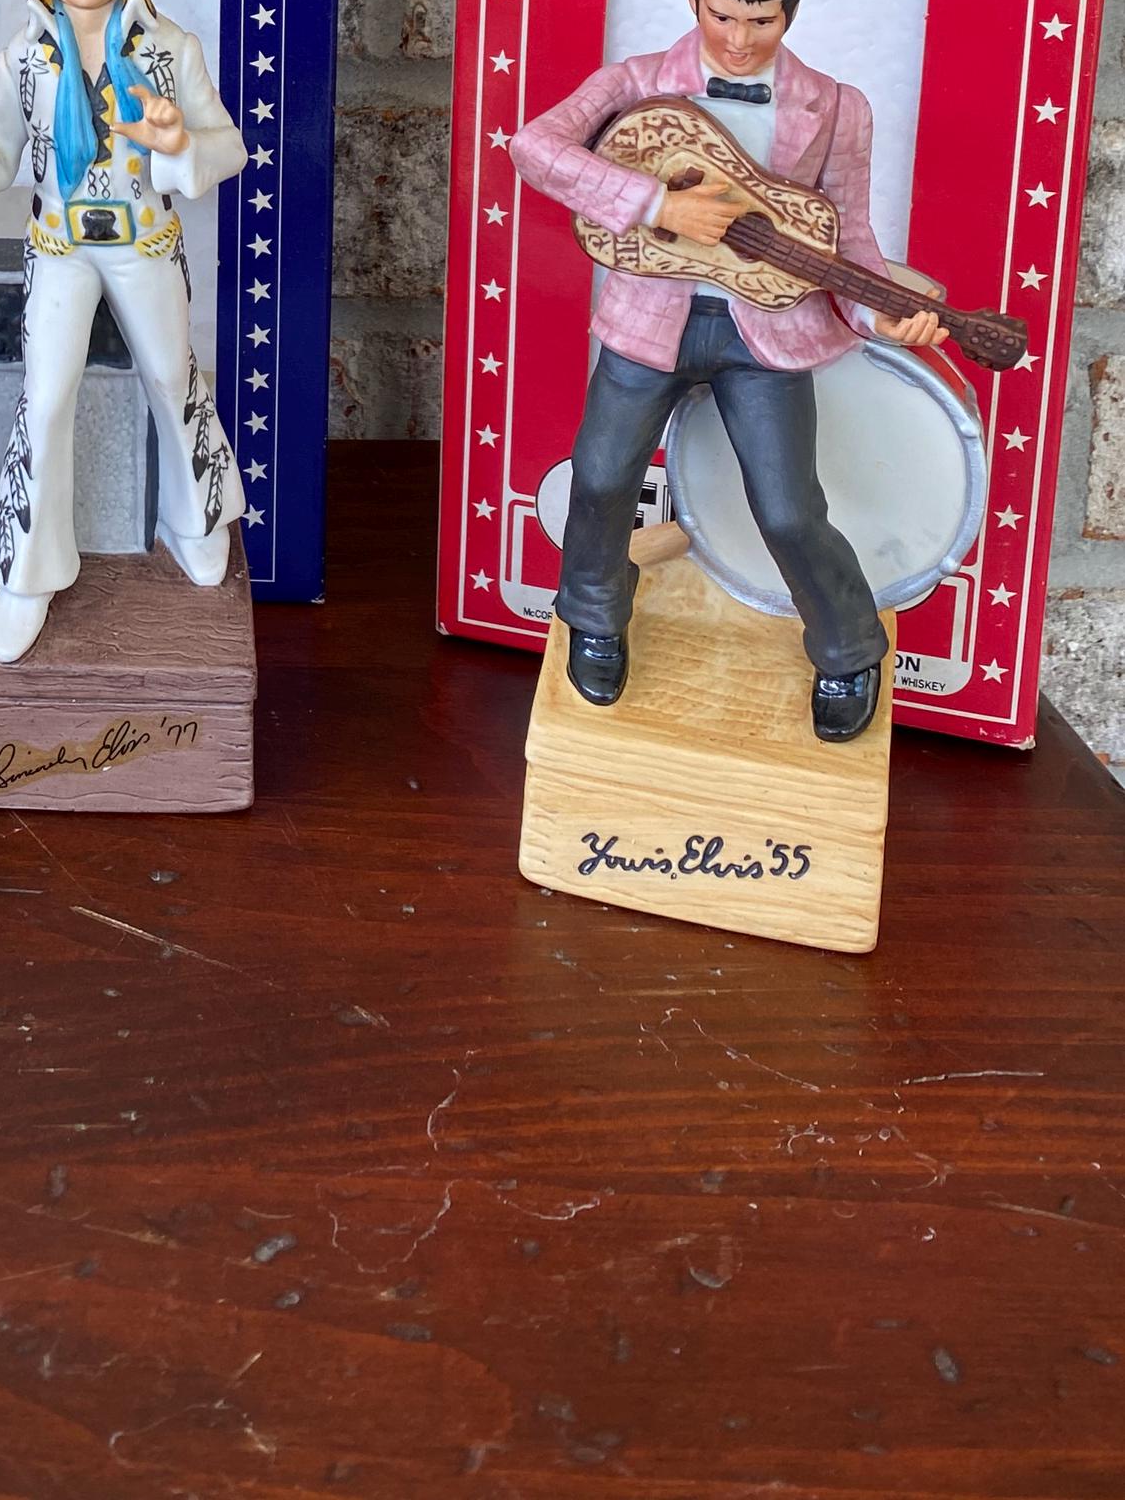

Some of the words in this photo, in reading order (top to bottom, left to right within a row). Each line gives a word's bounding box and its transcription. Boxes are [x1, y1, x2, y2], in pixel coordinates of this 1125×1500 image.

[900, 675, 947, 692] WHISKEY
[91, 720, 151, 769] Elvis
[160, 716, 198, 746] '77
[677, 834, 764, 880] Elvis
